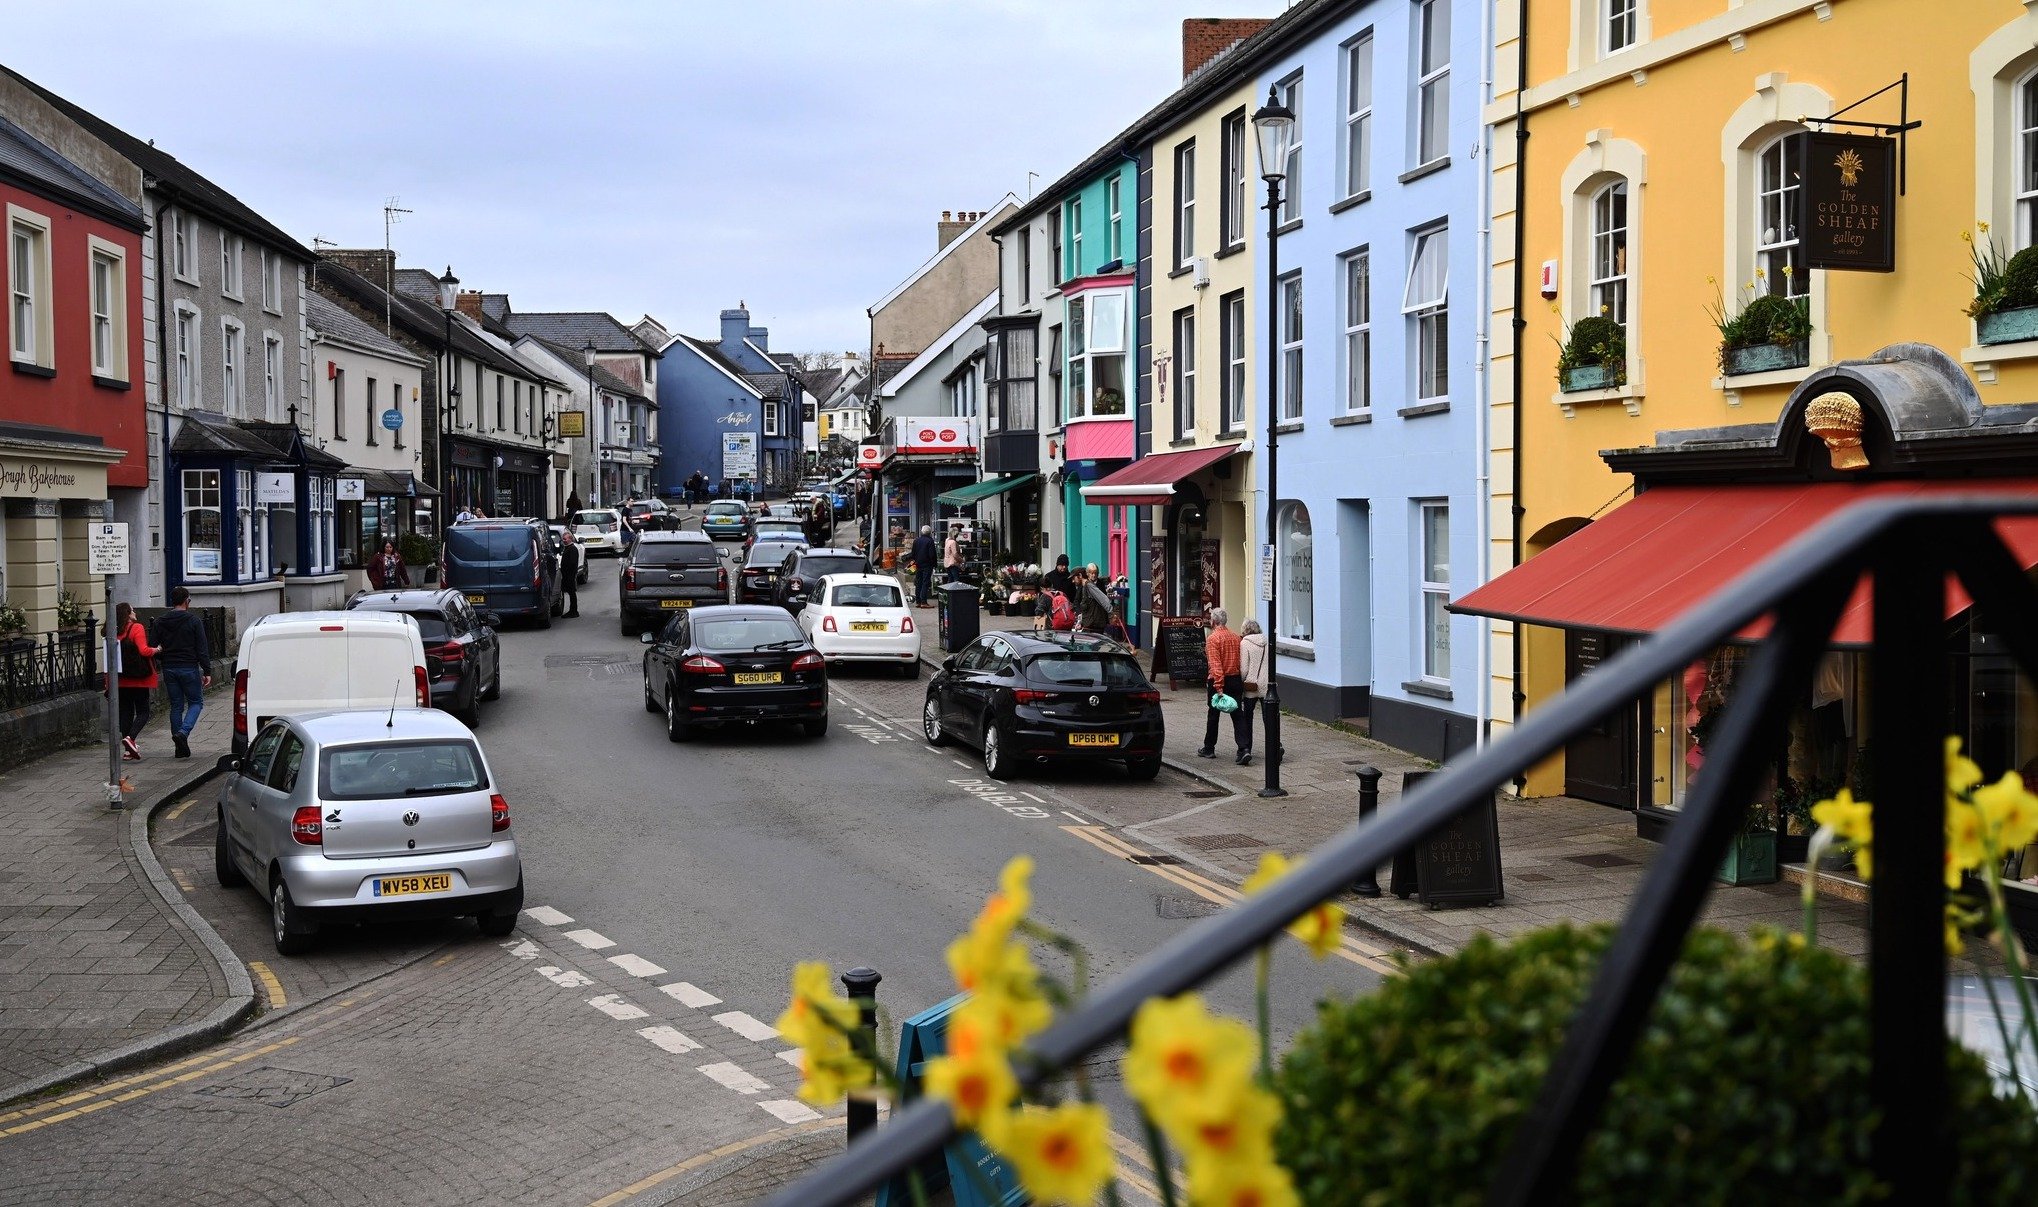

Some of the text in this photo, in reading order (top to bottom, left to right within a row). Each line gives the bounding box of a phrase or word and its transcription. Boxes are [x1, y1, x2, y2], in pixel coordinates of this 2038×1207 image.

[1840, 190, 1857, 201] The
[1818, 203, 1879, 215] GOLDEN
[1818, 215, 1879, 230] SHEAF
[1832, 231, 1865, 247] gallery
[716, 411, 752, 427] Angel
[28, 464, 76, 494] Bakehouse
[738, 673, 778, 682] SG60 URC
[1073, 734, 1115, 743] DP68 OMC
[947, 779, 1051, 819] DISABLED
[1448, 830, 1463, 839] The
[1431, 841, 1482, 851] GOLDEN
[1432, 851, 1482, 862] SHEAF
[1446, 864, 1472, 877] gallery
[382, 876, 449, 894] WV58 XEU
[977, 1155, 991, 1167] BOOKS
[989, 1165, 1001, 1177] GIFTS
